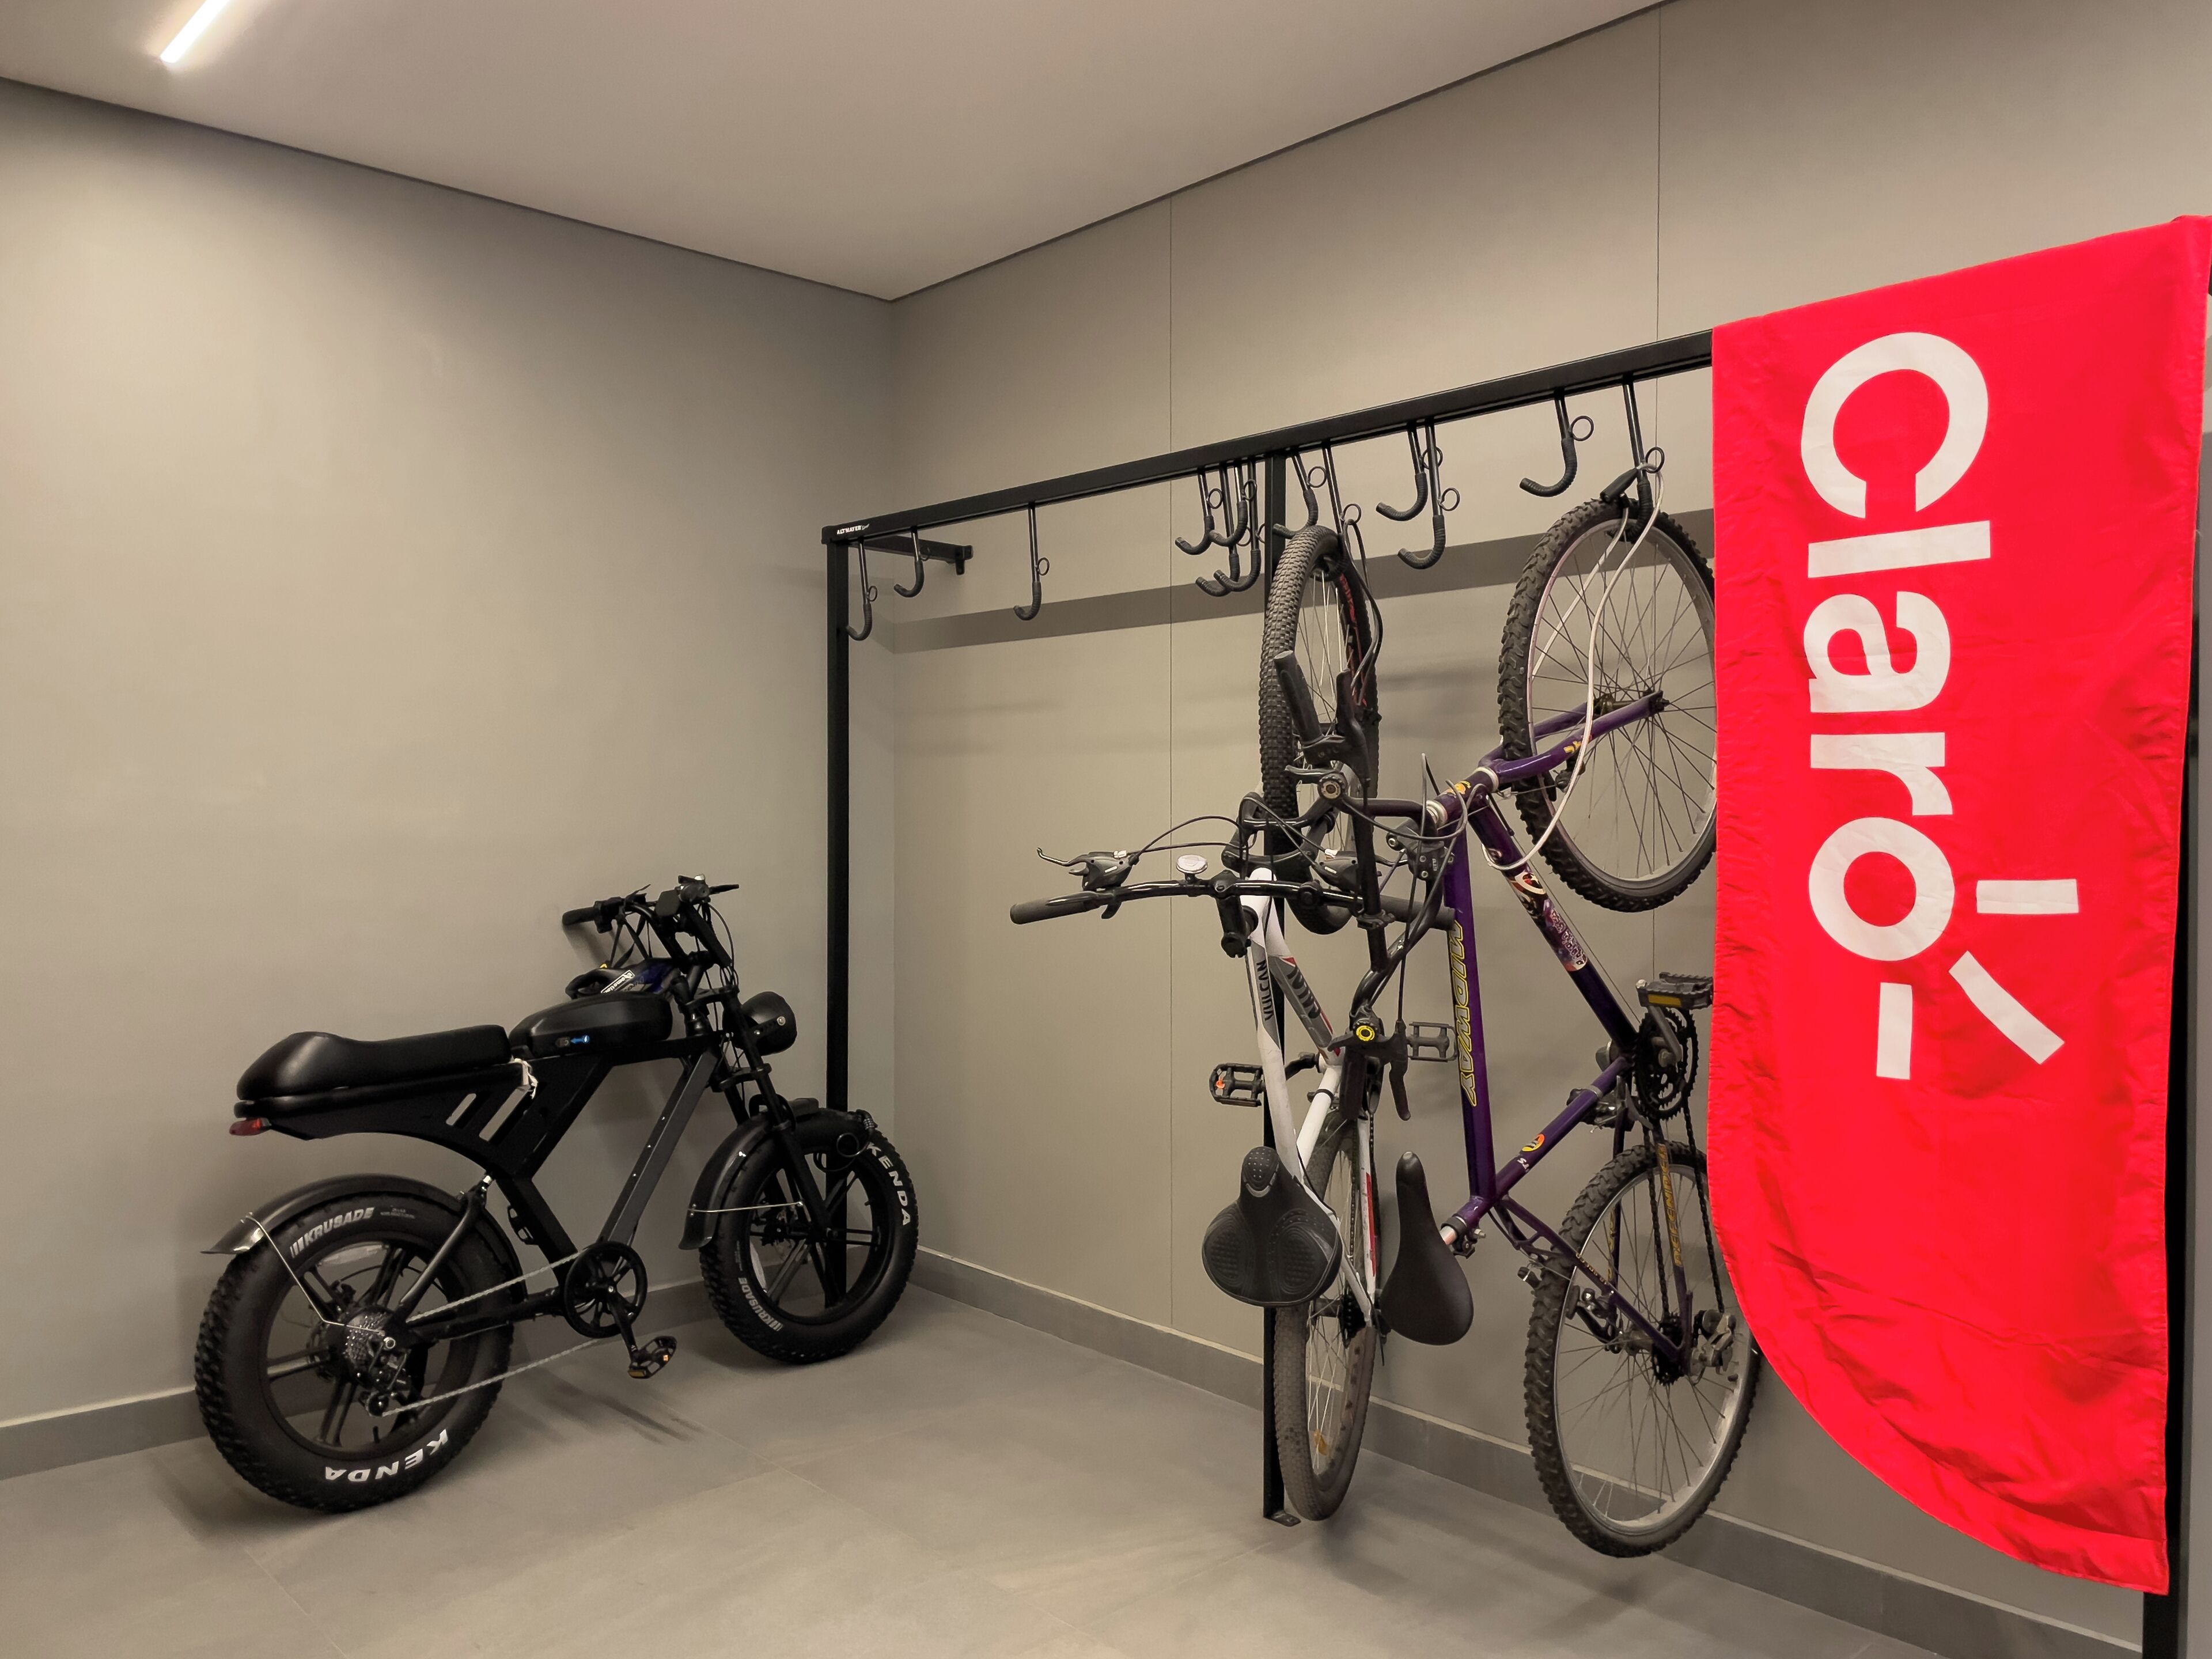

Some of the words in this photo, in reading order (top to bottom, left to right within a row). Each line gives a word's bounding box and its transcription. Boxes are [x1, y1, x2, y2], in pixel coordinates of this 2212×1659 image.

[1800, 331, 1991, 961] Claro
[1257, 960, 1274, 1021] VULCAN
[1450, 919, 1478, 1107] MIDWAY
[869, 1141, 910, 1226] KENDA
[1657, 1143, 1683, 1267] DEFENDER
[304, 1207, 374, 1245] KRUSADE
[738, 1277, 773, 1326] KRUSADE
[325, 1429, 449, 1482] KENDA
